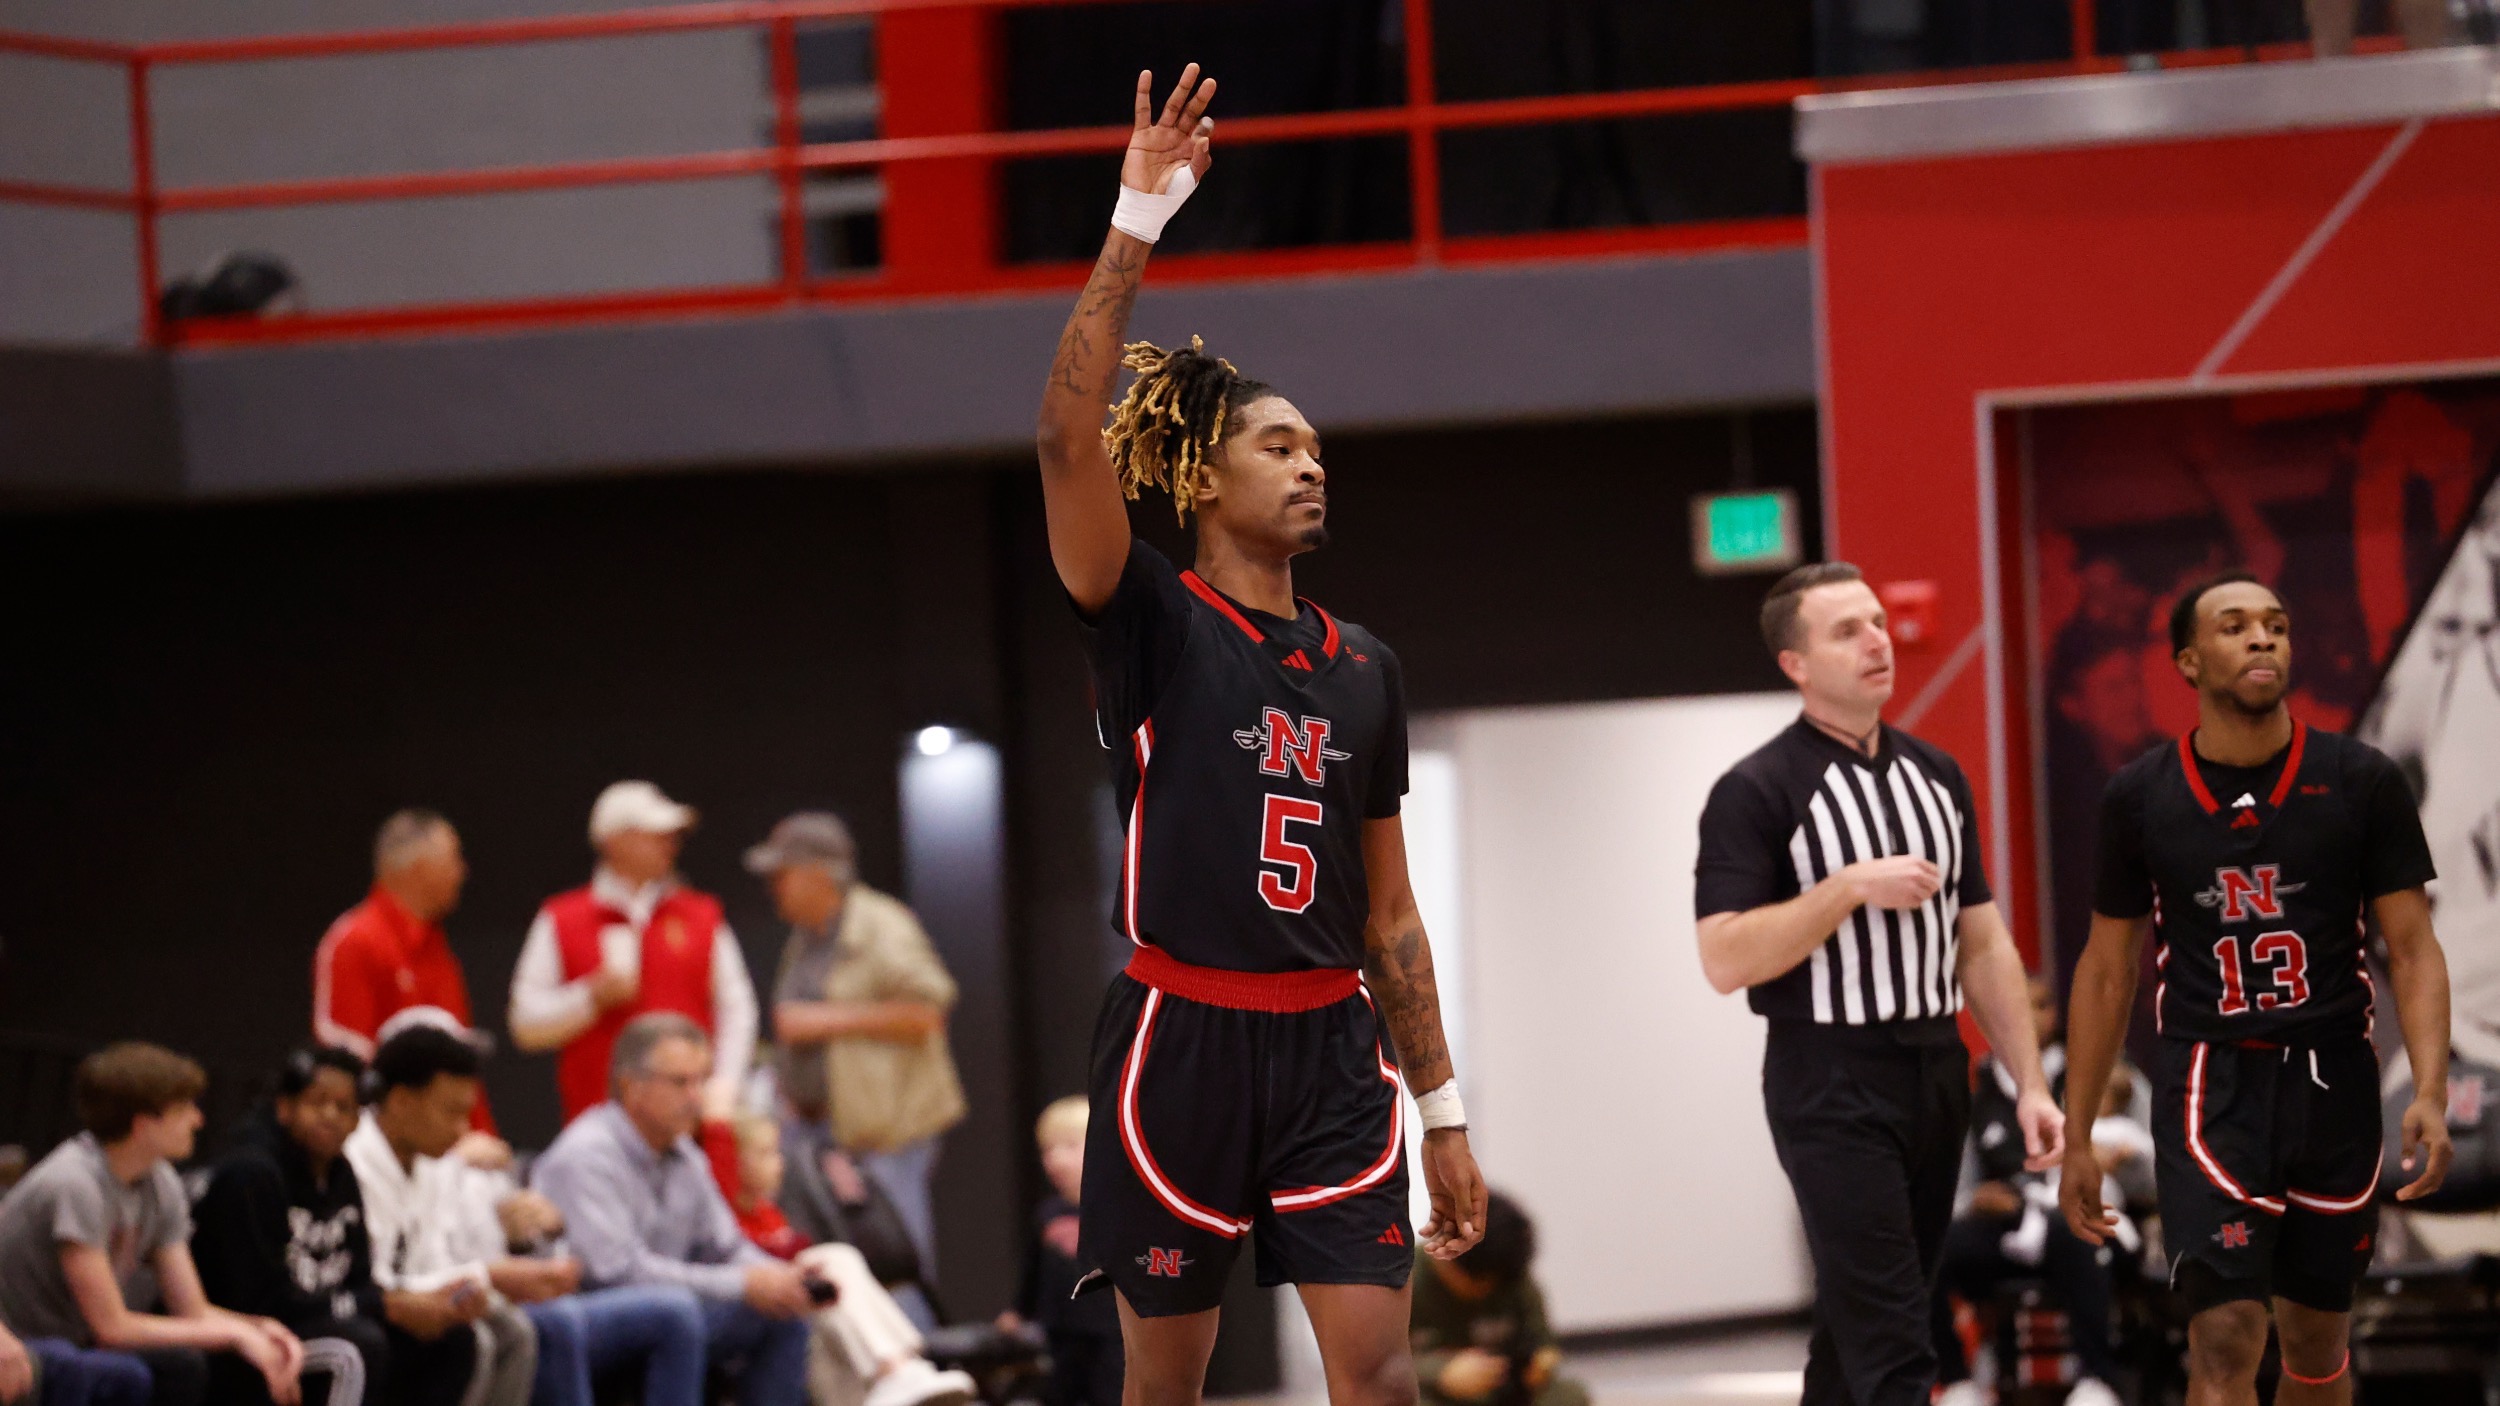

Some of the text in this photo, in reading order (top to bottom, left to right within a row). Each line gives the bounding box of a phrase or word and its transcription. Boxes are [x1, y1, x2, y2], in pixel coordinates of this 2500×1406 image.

[1259, 706, 1331, 787] N
[1258, 793, 1322, 914] 5
[2216, 864, 2285, 922] N
[2213, 930, 2310, 1016] 13
[1147, 1246, 1184, 1279] N
[2220, 1221, 2250, 1249] N
